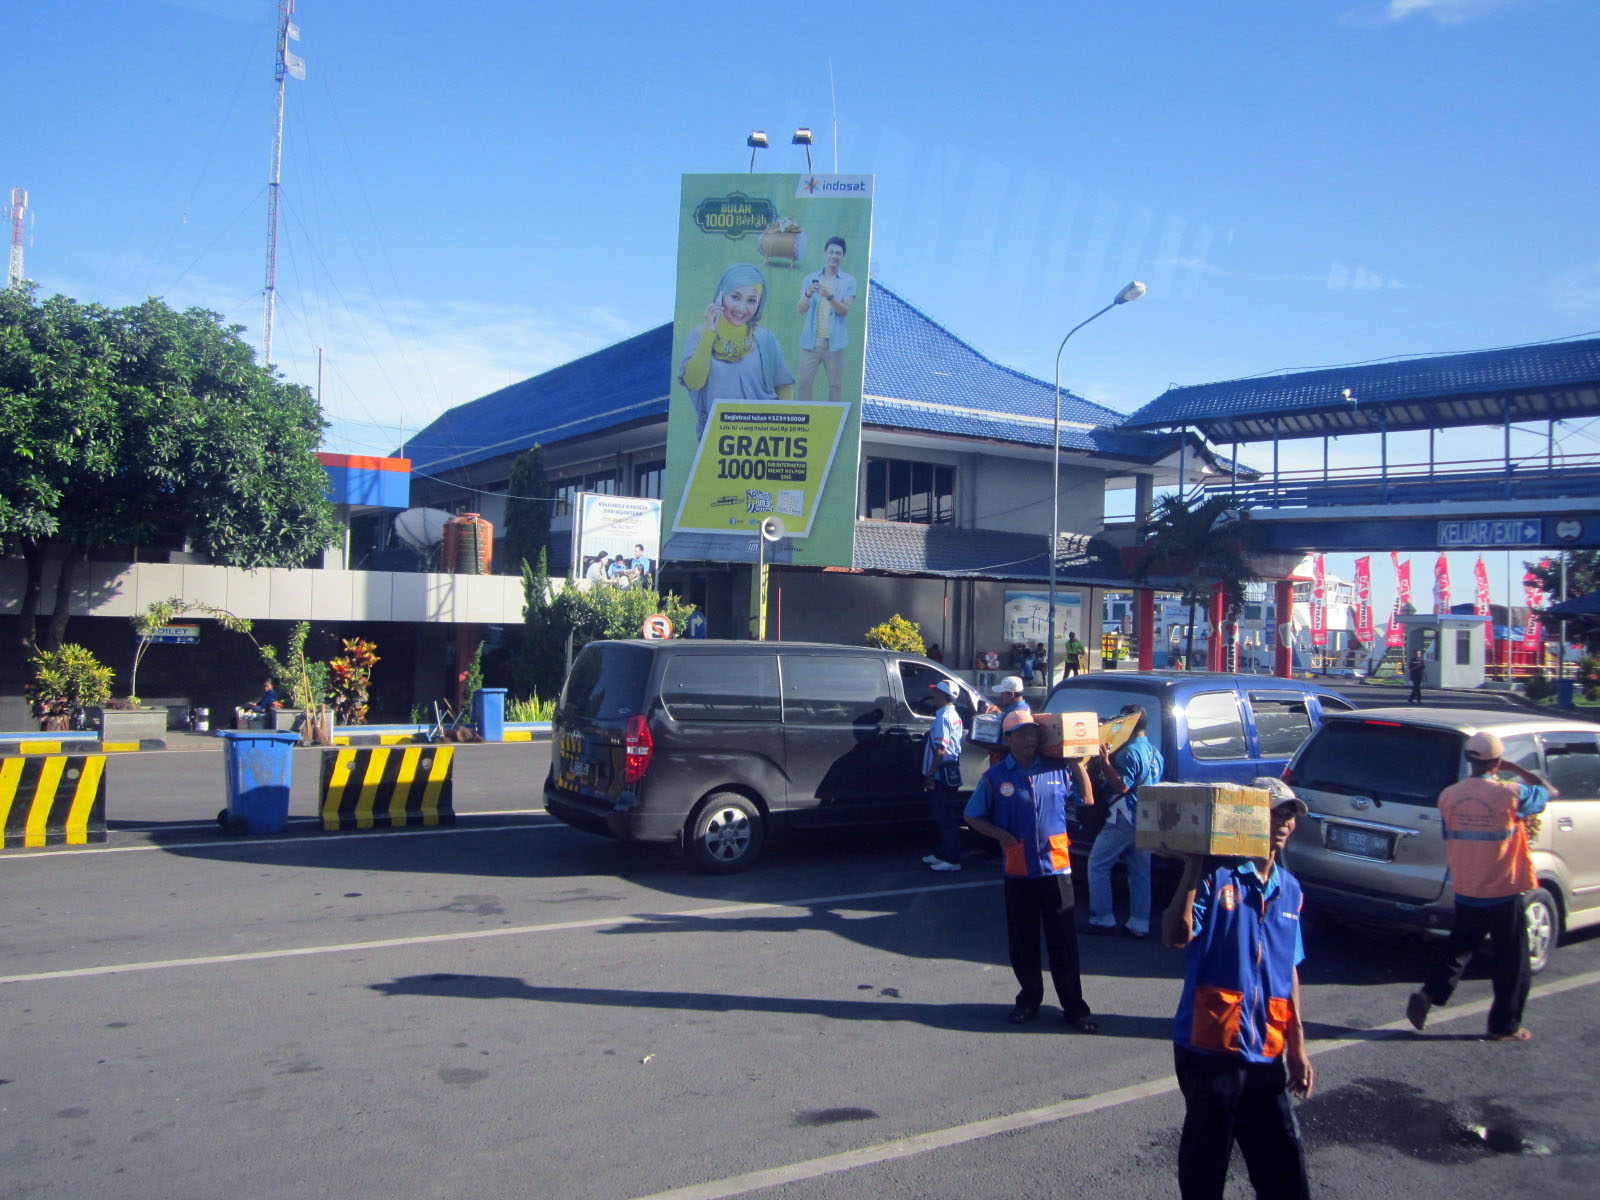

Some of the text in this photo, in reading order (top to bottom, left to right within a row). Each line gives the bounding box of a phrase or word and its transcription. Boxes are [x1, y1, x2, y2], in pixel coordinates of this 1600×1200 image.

[822, 180, 866, 192] indosat
[721, 203, 752, 214] BULAN
[705, 214, 734, 228] 1000
[718, 435, 808, 458] GRATIS
[717, 458, 766, 480] 1000
[1440, 521, 1523, 544] KELUAR/EXIT
